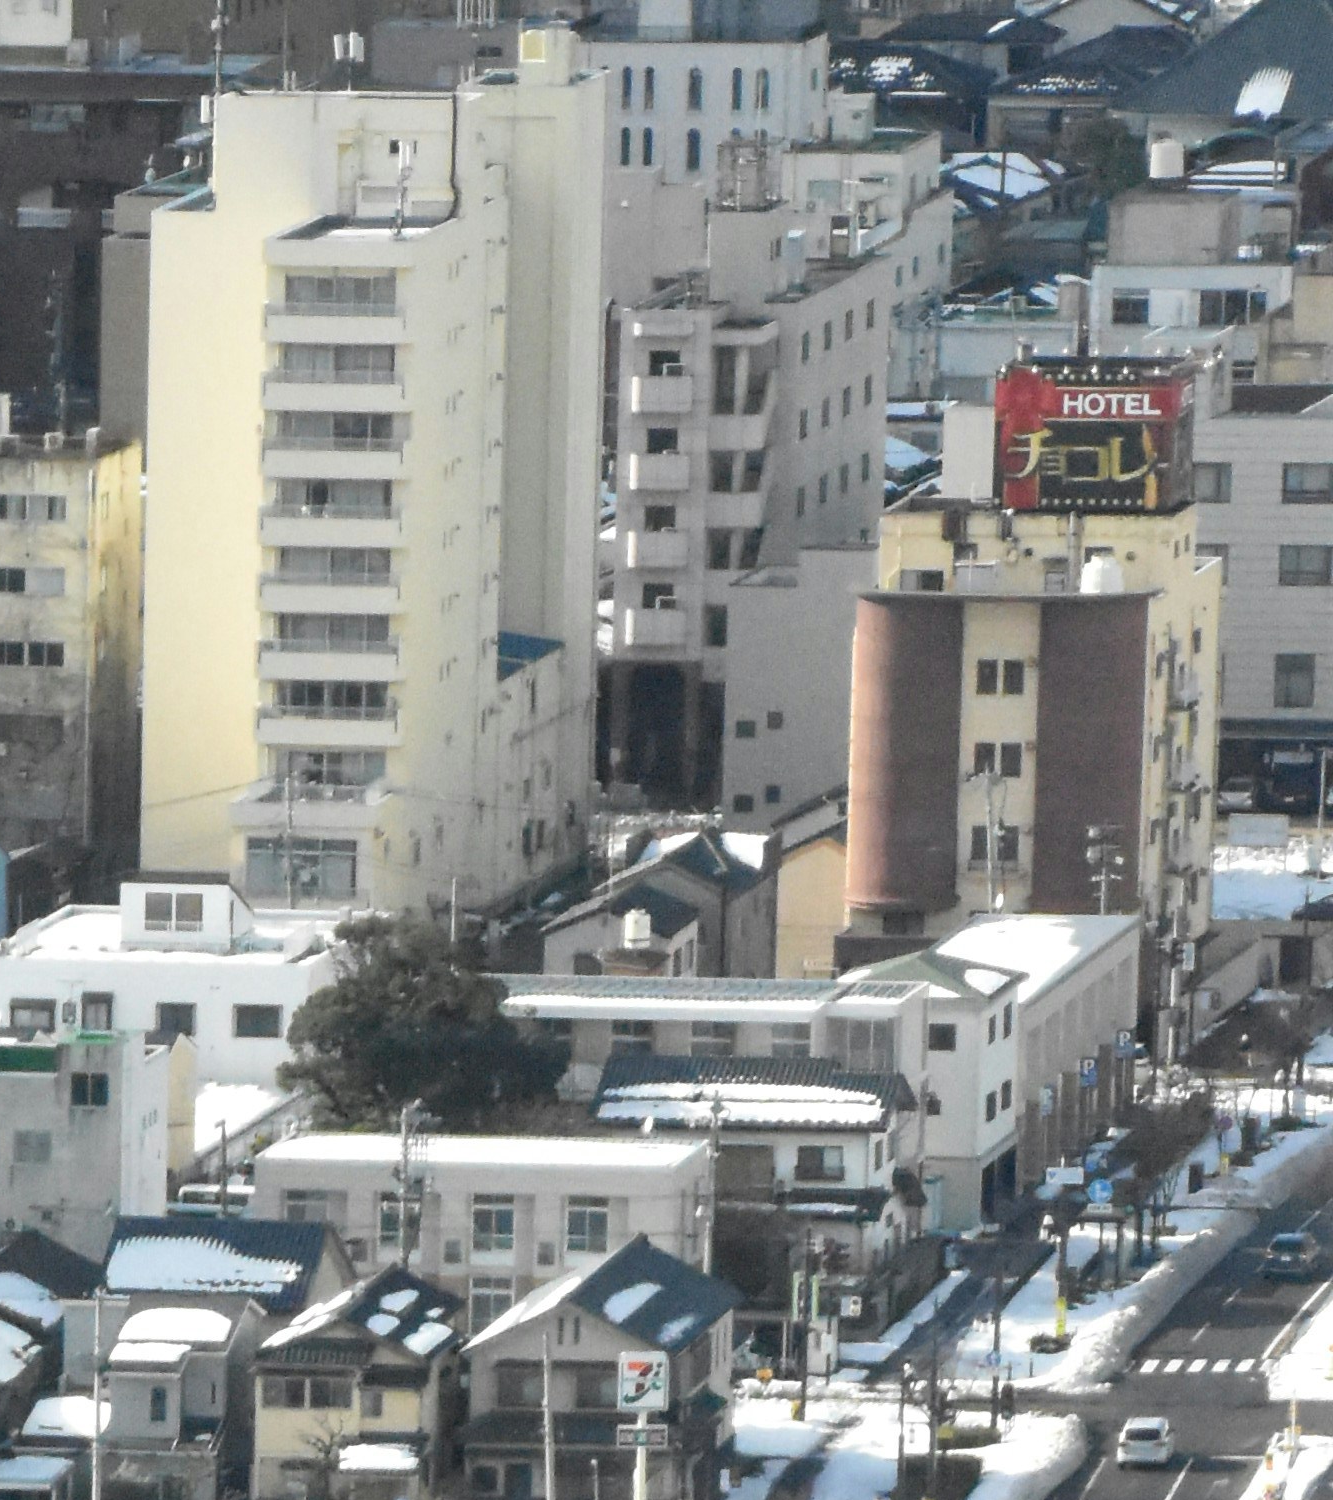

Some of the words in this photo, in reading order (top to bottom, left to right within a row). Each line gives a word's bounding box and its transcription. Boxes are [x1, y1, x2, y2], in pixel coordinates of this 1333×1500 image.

[1063, 393, 1162, 415] HOTEL
[1116, 1031, 1131, 1047] P
[1083, 1058, 1095, 1075] P
